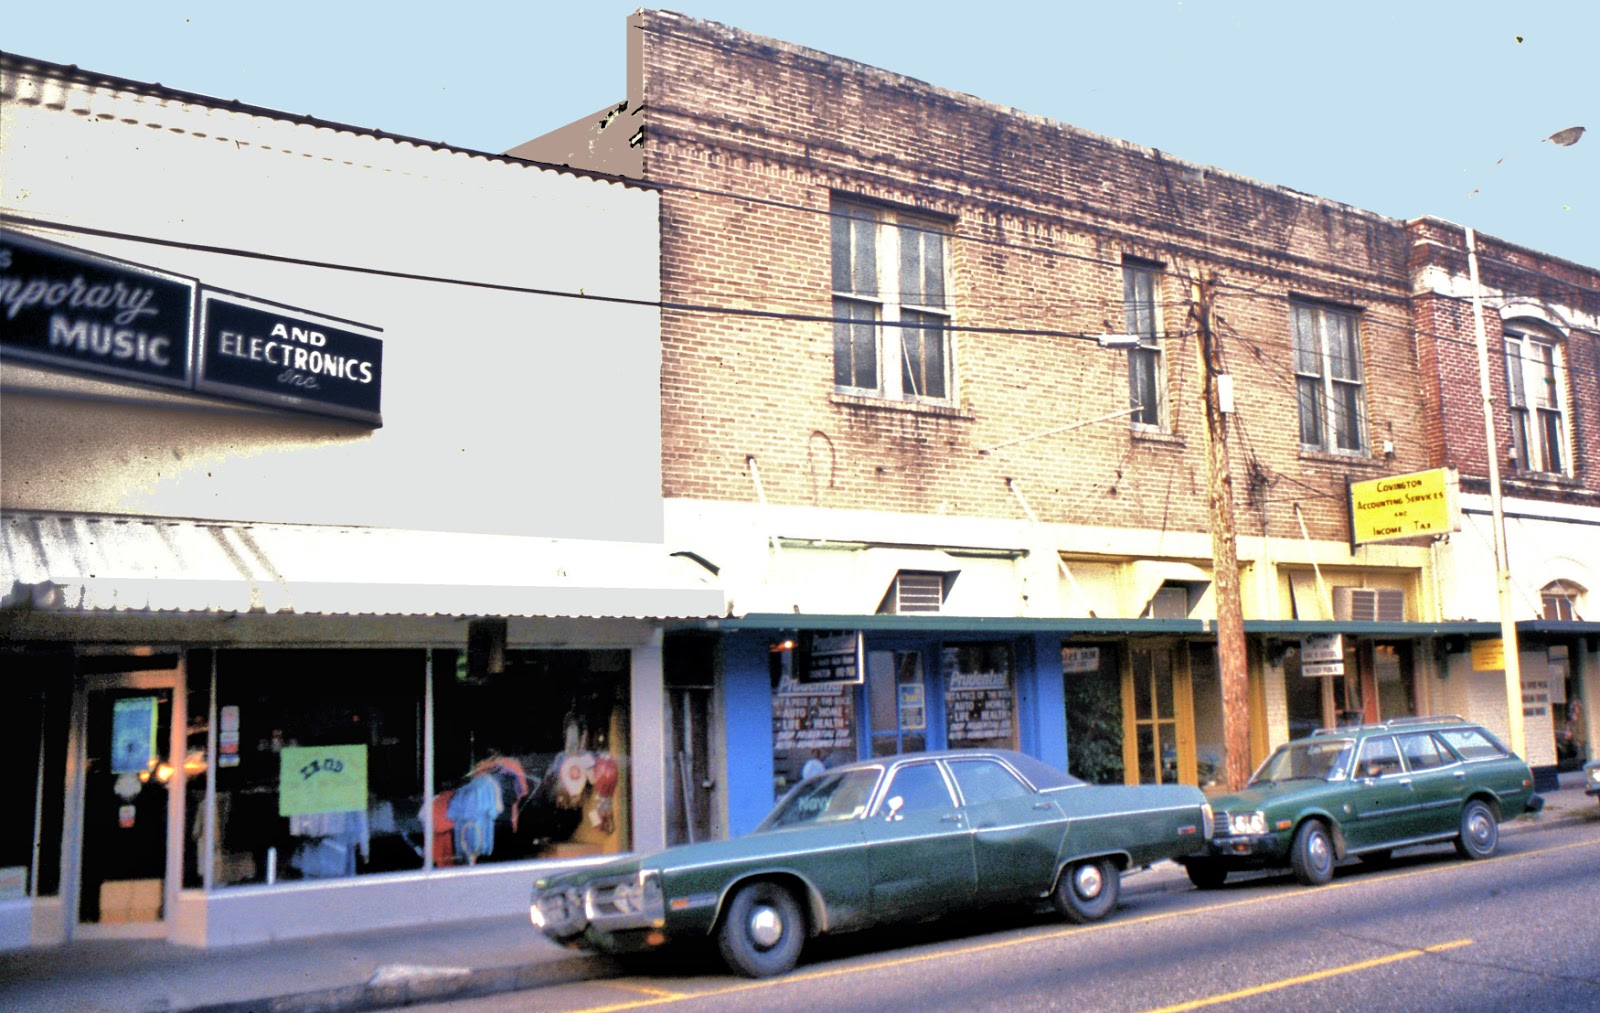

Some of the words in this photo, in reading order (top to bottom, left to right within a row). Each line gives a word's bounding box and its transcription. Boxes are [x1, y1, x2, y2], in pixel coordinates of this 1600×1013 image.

[51, 313, 171, 367] MUSIC
[270, 323, 326, 347] AND
[219, 330, 373, 383] ELECTRONICS
[783, 708, 806, 718] AUTO
[819, 706, 843, 717] HOME
[955, 702, 975, 711] AUTO
[955, 712, 970, 722] LIFE
[783, 719, 800, 730] LIFE
[814, 718, 844, 729] HEALTH
